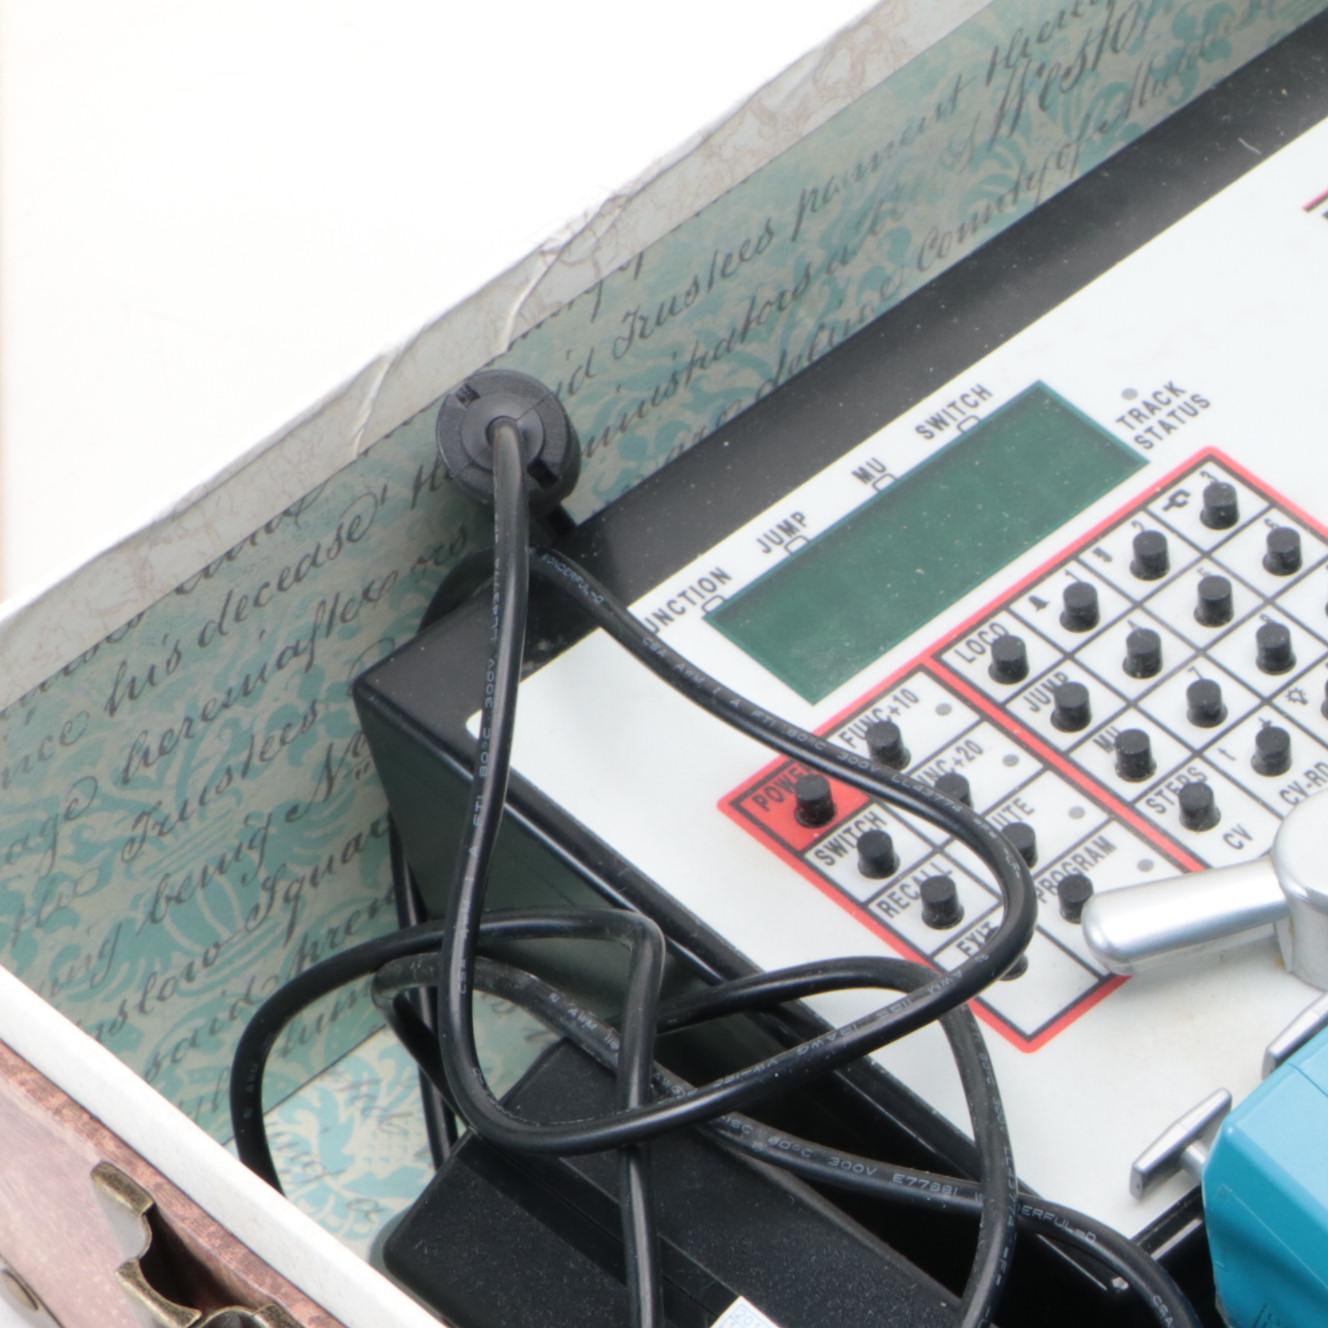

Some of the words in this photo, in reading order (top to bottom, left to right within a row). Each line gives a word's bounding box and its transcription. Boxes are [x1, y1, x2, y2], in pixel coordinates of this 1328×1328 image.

[913, 383, 994, 442] SWITCH
[1114, 379, 1188, 432] TRACK
[1132, 391, 1212, 452] STATUS
[851, 455, 889, 487] MU
[756, 510, 810, 556] JUMP
[646, 566, 733, 637] UNCTION
[813, 812, 889, 868] SWITCH
[991, 796, 1036, 834] UTE
[1221, 822, 1254, 852] CV
